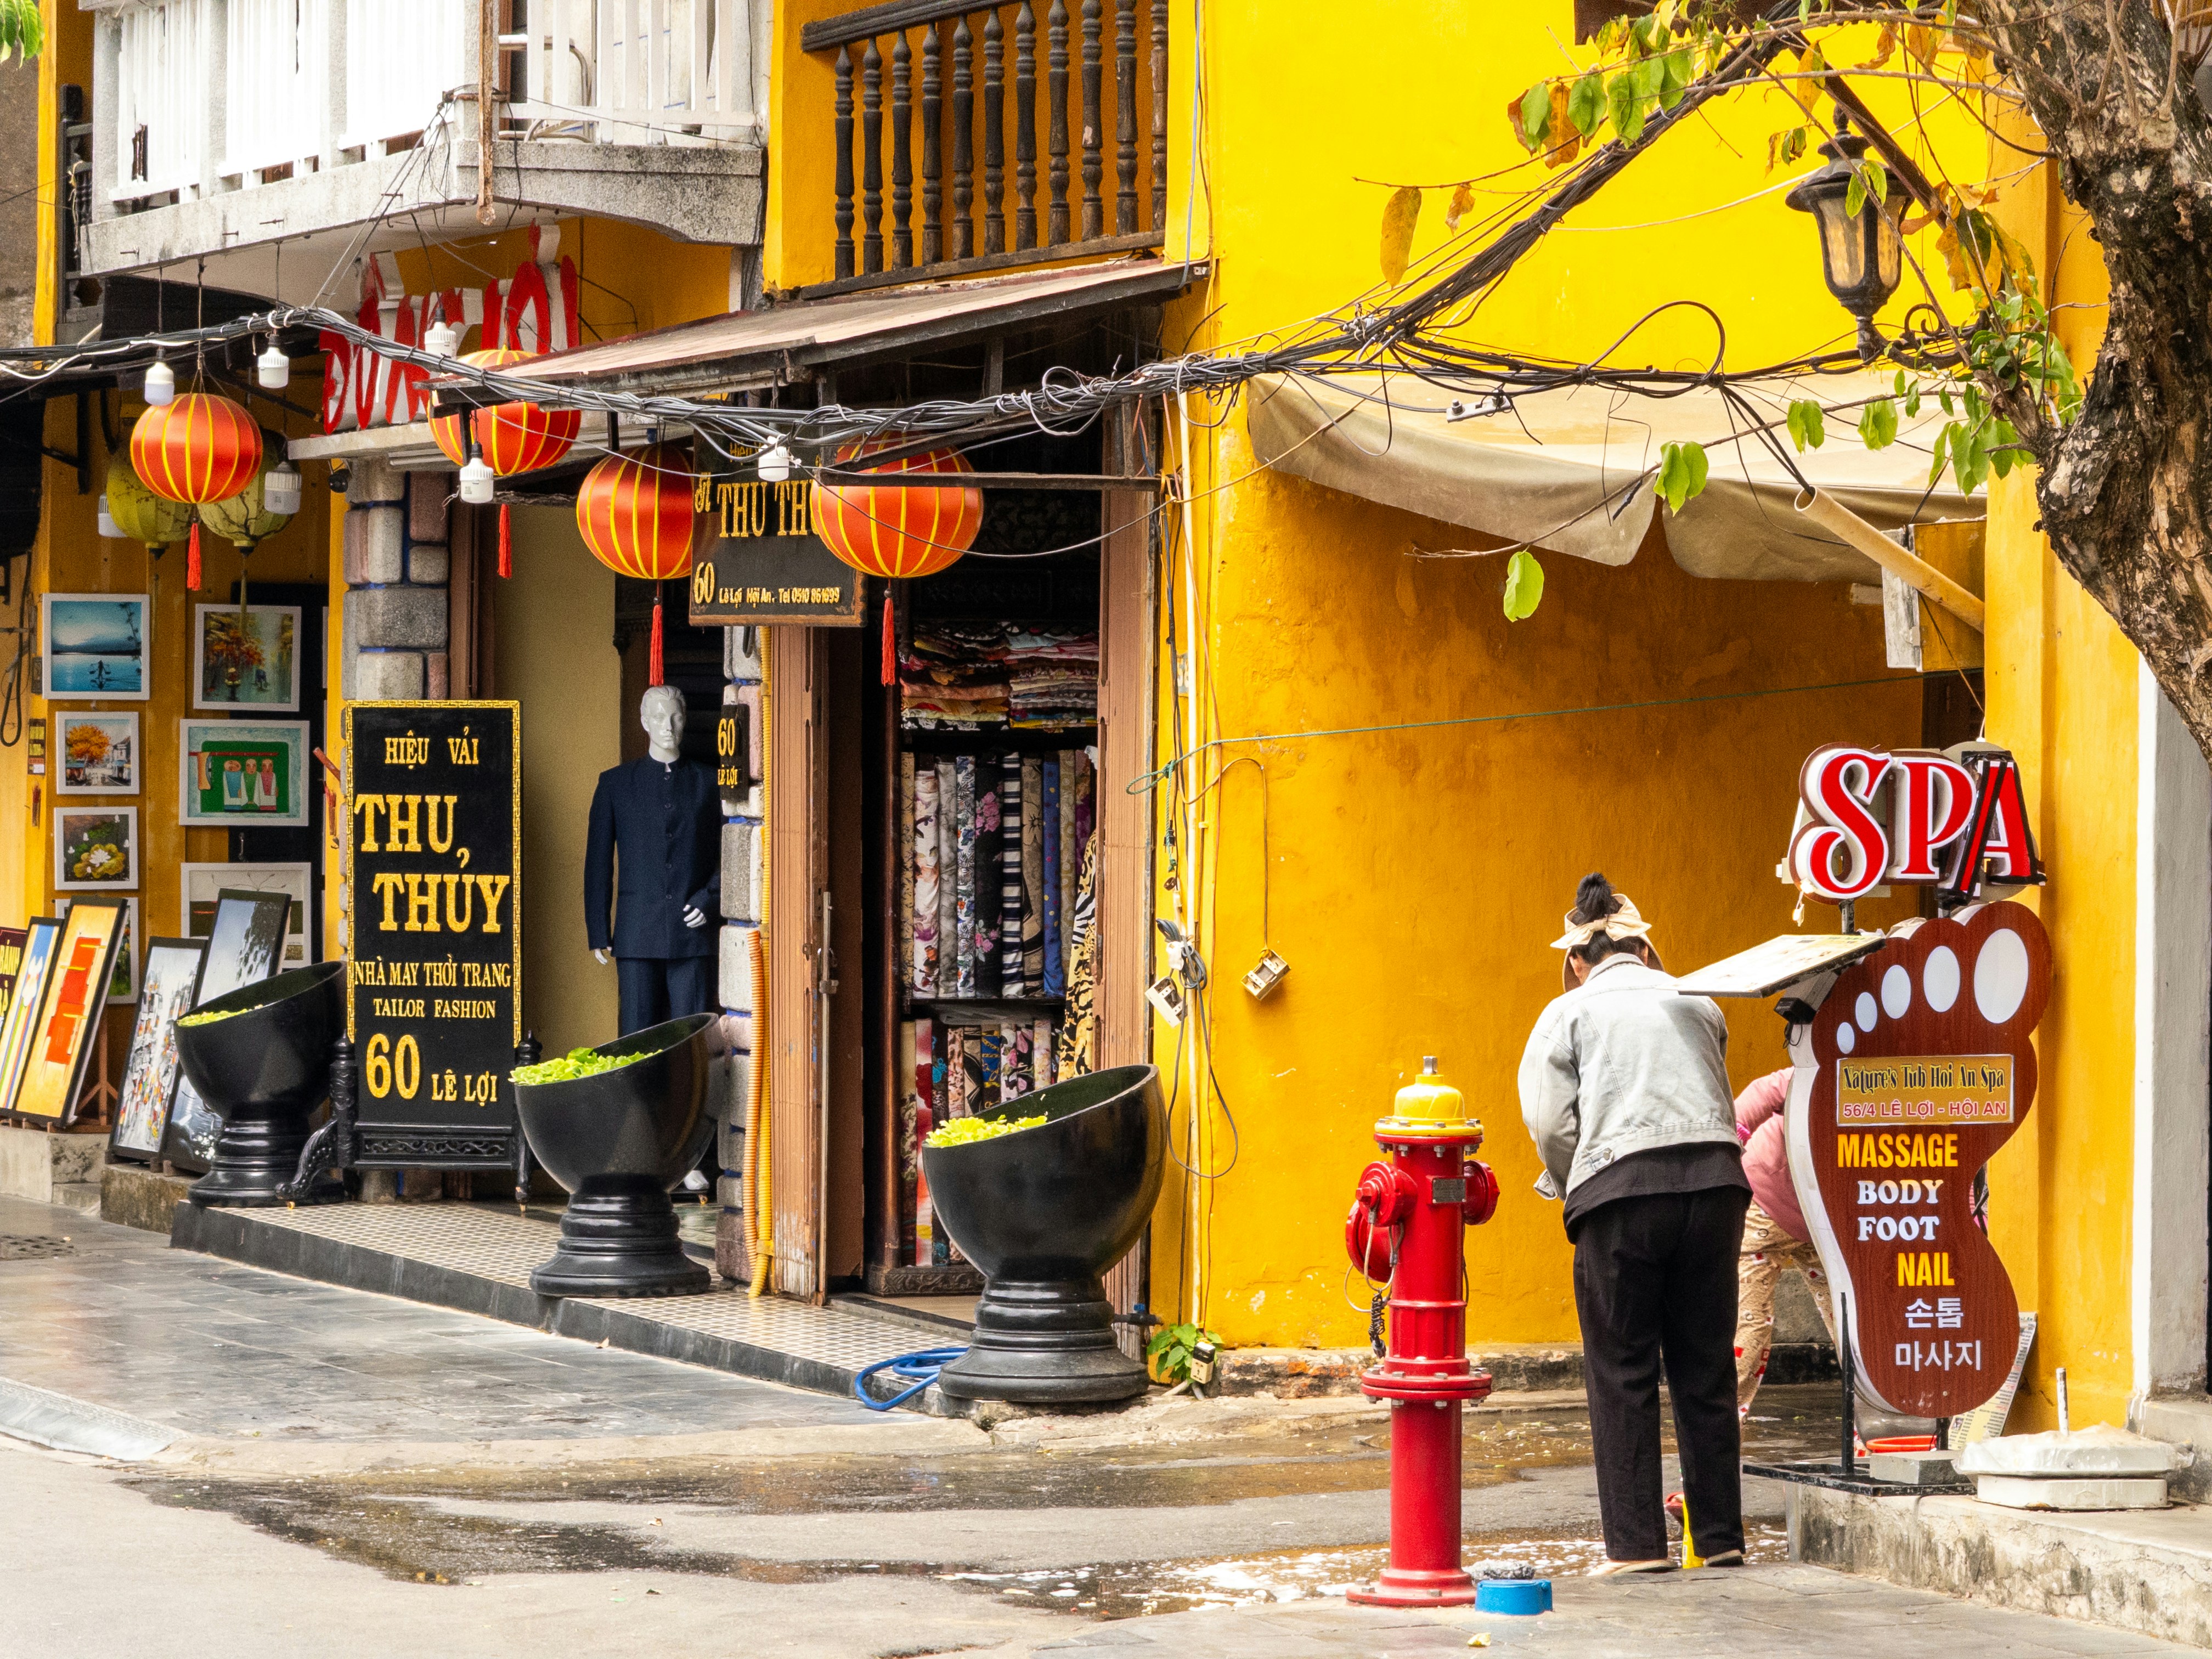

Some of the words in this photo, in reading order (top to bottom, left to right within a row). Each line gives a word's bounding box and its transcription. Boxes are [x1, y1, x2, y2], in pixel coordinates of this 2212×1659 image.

[717, 482, 767, 538] THU
[694, 562, 714, 603] 60
[778, 588, 790, 603] Tel
[791, 588, 810, 603] 0510
[385, 730, 430, 769] HIỆU
[448, 726, 479, 764] VẢI
[718, 718, 735, 756] 60
[354, 794, 457, 853] THU
[1801, 747, 2046, 899] SPA
[372, 848, 510, 933] THỦY
[355, 956, 386, 986] NHÀ
[389, 962, 419, 986] MAY
[424, 953, 458, 986] THỜI
[462, 963, 511, 988] TRANG
[373, 998, 425, 1017] TAILOR
[434, 1000, 496, 1018] FASHION
[366, 1034, 420, 1099] 60
[431, 1069, 457, 1101] LÊ
[464, 1071, 497, 1107] LỢI
[1843, 1065, 1898, 1095] Nature's
[1900, 1063, 1927, 1090] Tub
[1929, 1062, 1954, 1090] Hoi
[1957, 1063, 1977, 1089] An
[1980, 1063, 2005, 1095] Spa
[1843, 1103, 1876, 1118] 56/4
[1880, 1099, 1901, 1116] LÊ
[1906, 1101, 1934, 1119] LỢI
[1949, 1097, 1978, 1118] HỘI
[1982, 1101, 2006, 1115] AN
[1837, 1133, 1959, 1168] MASSAGE
[1857, 1179, 1944, 1205] BODY
[1857, 1216, 1940, 1241] FOOT
[1898, 1252, 1955, 1286] NAIL
[1905, 1297, 1964, 1329] 손톱
[1895, 1340, 1981, 1372] 마사지
